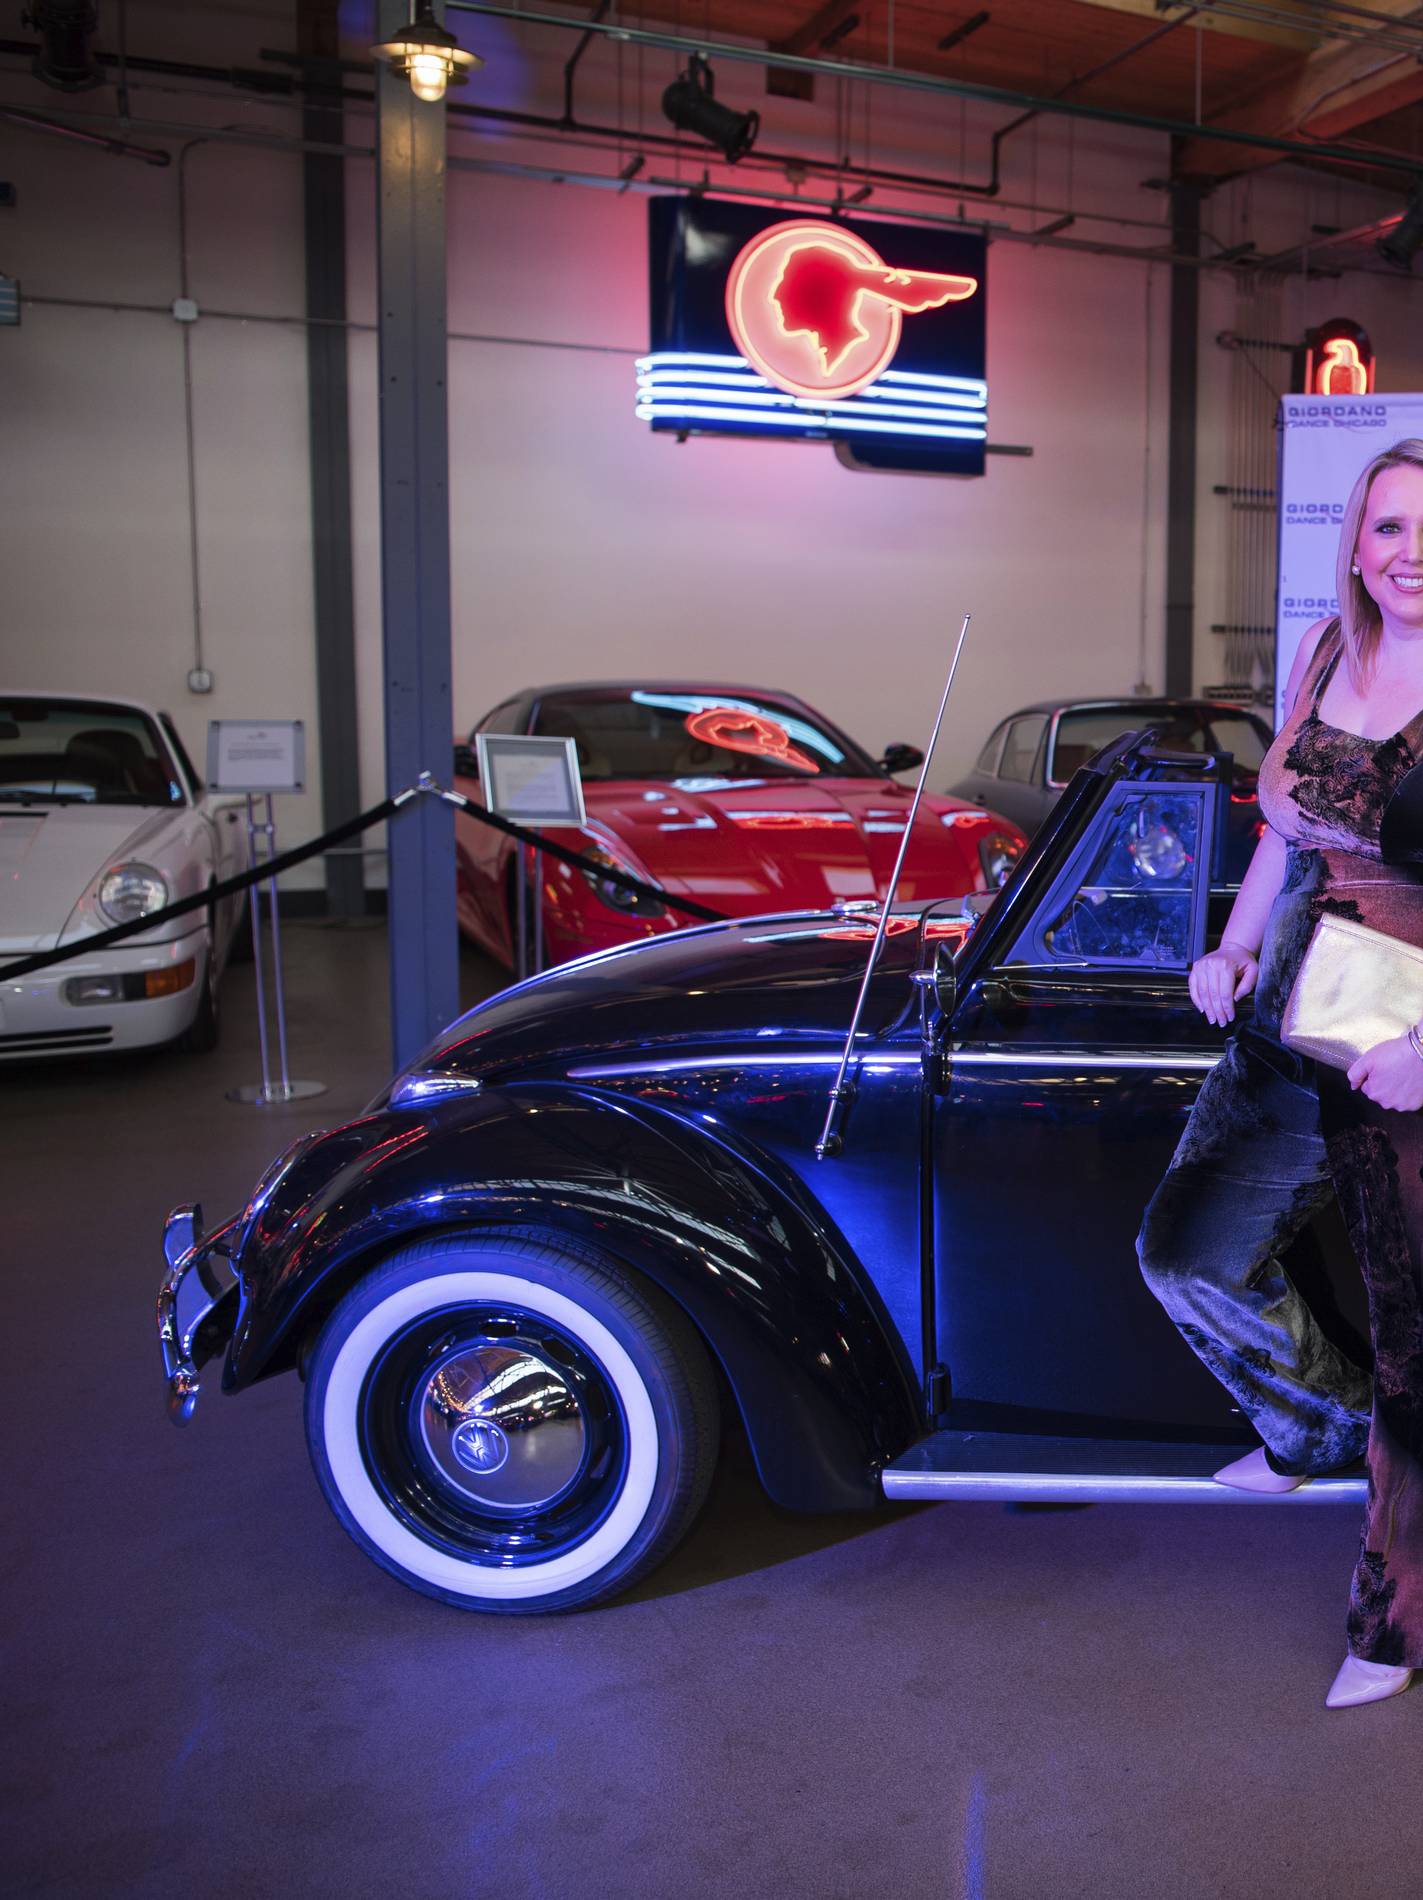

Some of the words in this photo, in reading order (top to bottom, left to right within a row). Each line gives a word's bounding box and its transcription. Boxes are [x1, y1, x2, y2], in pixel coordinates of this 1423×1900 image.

[1288, 405, 1387, 417] GIORDANO
[1288, 419, 1329, 428] DANCE
[1333, 418, 1387, 428] CHICAGO
[1286, 503, 1344, 514] GIORD
[1286, 516, 1328, 525] DANCE
[1283, 598, 1340, 609] GIORD
[1283, 610, 1325, 619] DANCE
